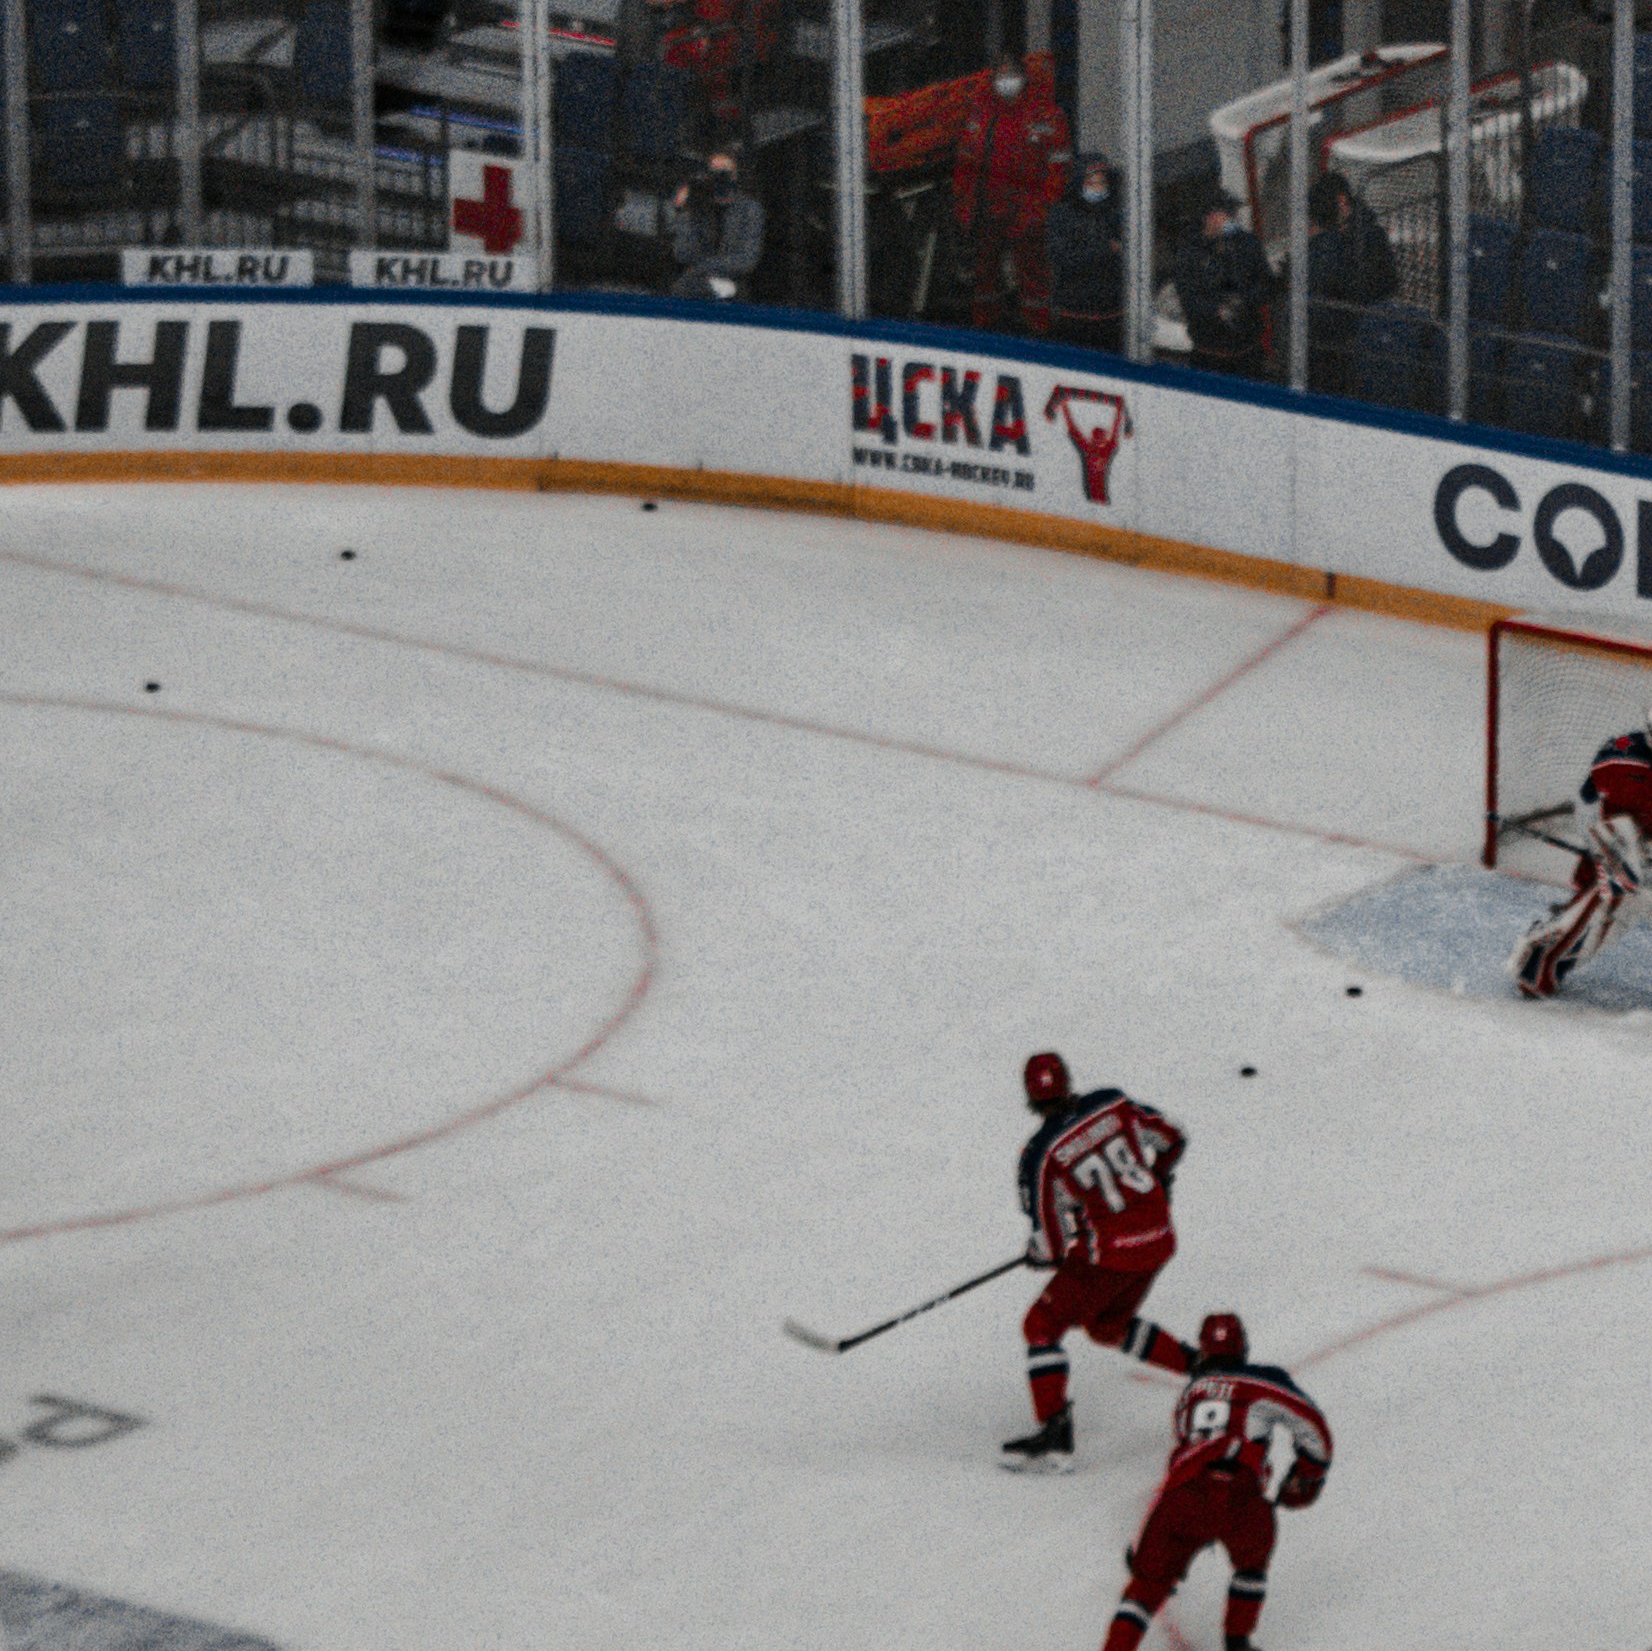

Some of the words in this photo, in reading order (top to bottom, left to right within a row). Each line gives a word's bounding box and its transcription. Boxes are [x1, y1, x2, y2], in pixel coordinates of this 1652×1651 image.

[147, 254, 290, 283] KHL.RU
[374, 258, 513, 288] KHL.RU
[0, 320, 556, 437] KHL.RU
[851, 354, 1032, 456] ЦСКА
[1071, 1132, 1157, 1214] 78
